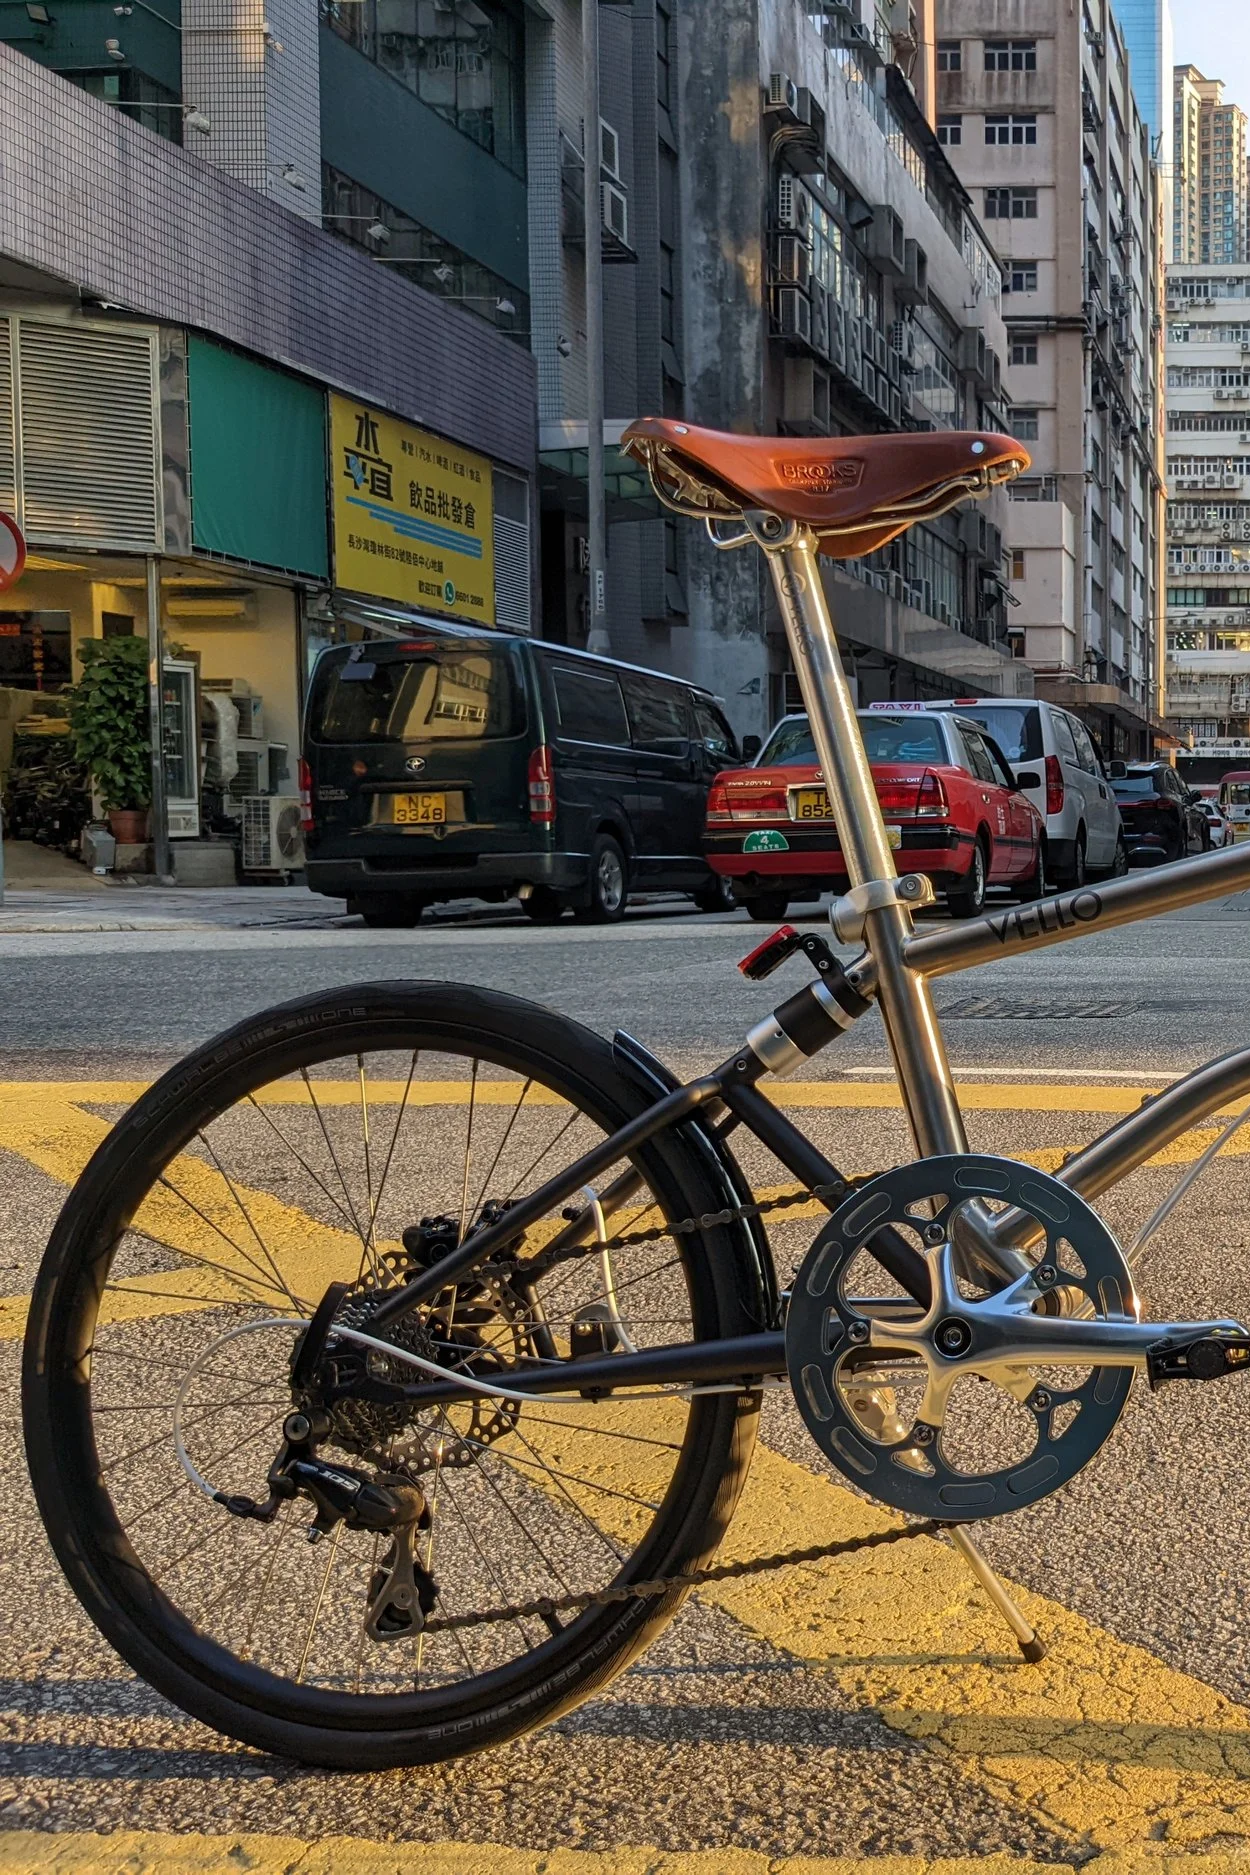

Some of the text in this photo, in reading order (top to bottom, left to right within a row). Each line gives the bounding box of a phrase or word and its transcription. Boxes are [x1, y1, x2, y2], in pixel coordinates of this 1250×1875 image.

[782, 463, 858, 480] BROOKS
[409, 479, 476, 531] 飲品批發倉
[872, 703, 921, 711] TAXI
[407, 795, 432, 809] NC
[396, 807, 443, 822] 3348
[752, 843, 780, 851] SEATS
[760, 835, 769, 845] 4
[984, 890, 1102, 945] VELLO
[320, 1006, 367, 1020] ONE
[428, 1719, 473, 1741] ONE
